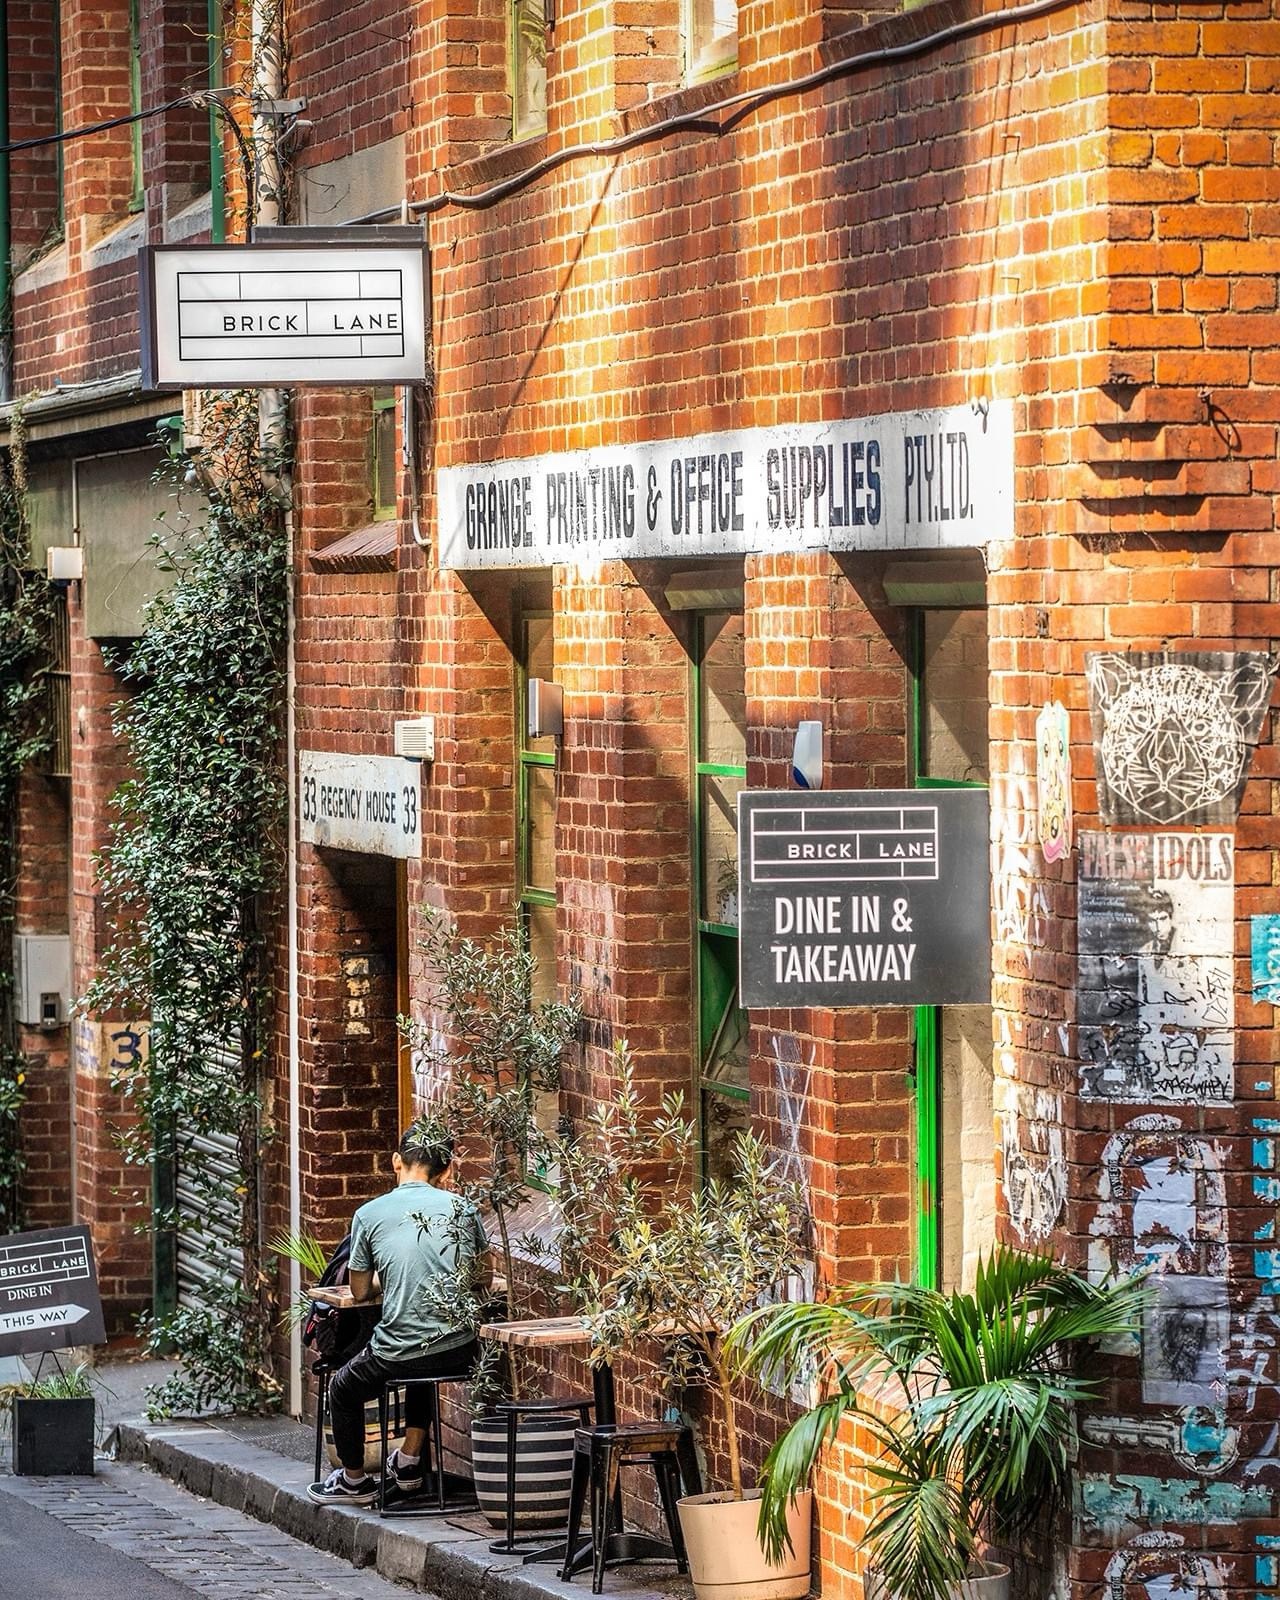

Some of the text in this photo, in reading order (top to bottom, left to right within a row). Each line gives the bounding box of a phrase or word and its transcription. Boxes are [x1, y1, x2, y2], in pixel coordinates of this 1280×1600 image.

[223, 313, 399, 332] BRICK LANE
[465, 475, 533, 550] GRANGE
[546, 463, 636, 546] PRINTING
[646, 464, 663, 532] &
[670, 450, 745, 536] OFFICE
[766, 439, 882, 530] SUPPLIES
[303, 775, 417, 835] 33 REGENCY HOUSE 33
[787, 841, 934, 859] BRICK LANE
[1080, 832, 1233, 882] FALSE IDOLS
[775, 895, 914, 935] DINE IN &
[770, 943, 917, 984] TAKEAWAY
[0, 1255, 86, 1277] BRICK LANE
[7, 1284, 53, 1301] DINE IN
[3, 1309, 69, 1329] THIS WAY
